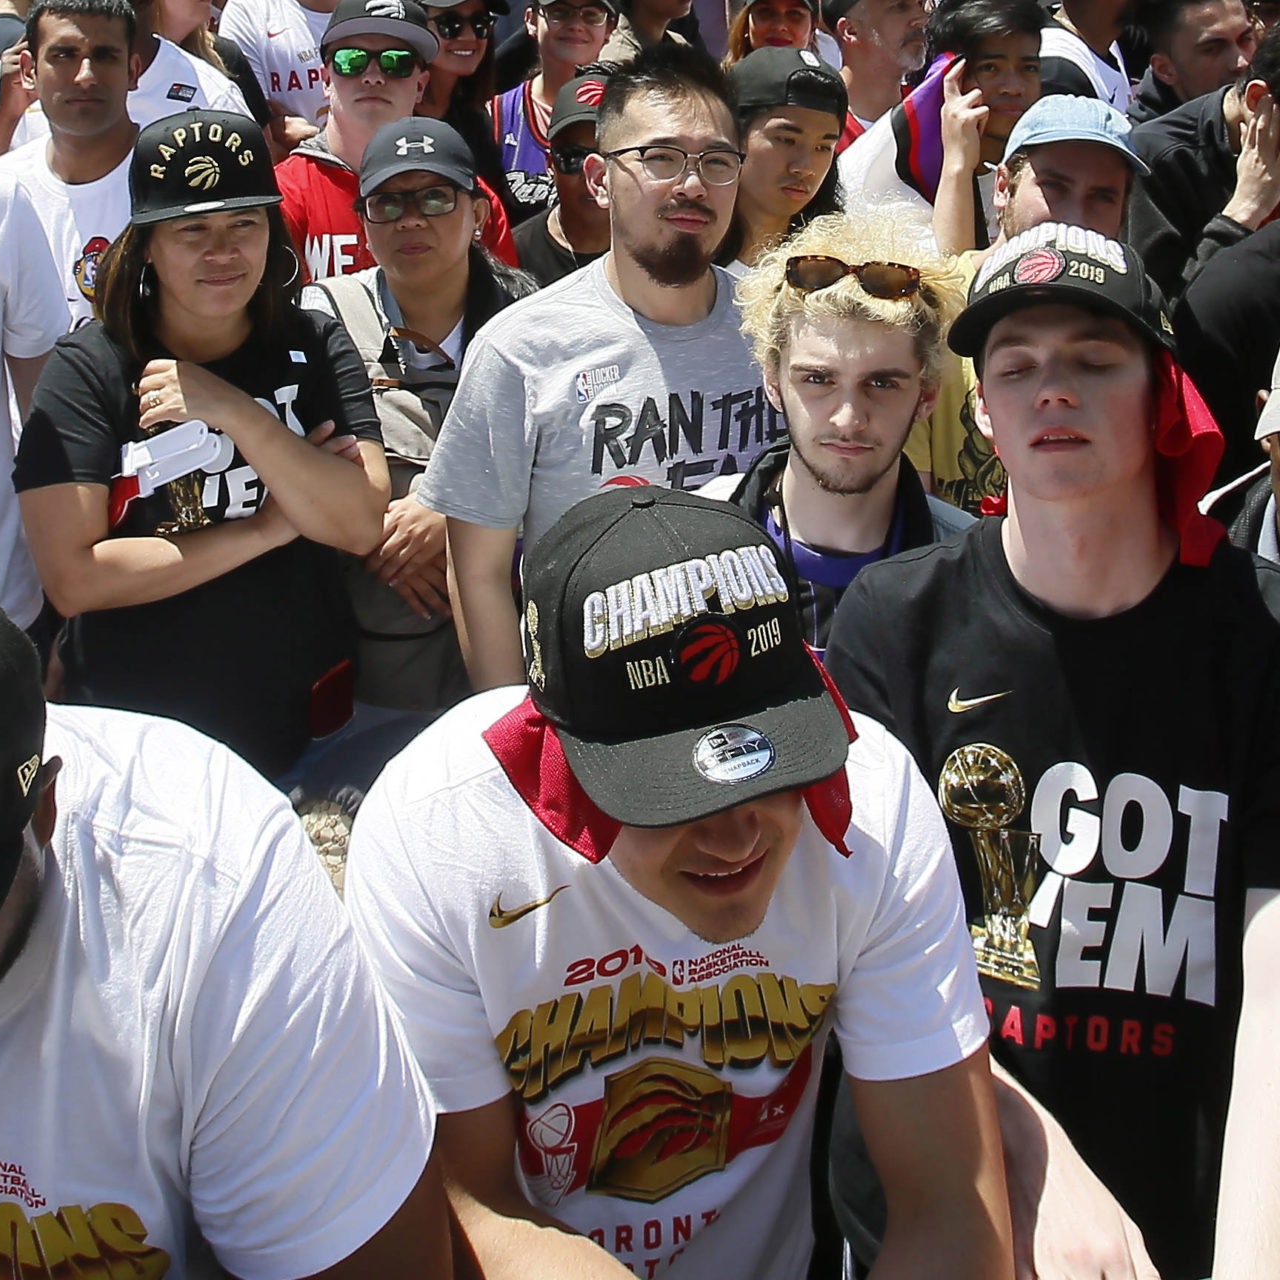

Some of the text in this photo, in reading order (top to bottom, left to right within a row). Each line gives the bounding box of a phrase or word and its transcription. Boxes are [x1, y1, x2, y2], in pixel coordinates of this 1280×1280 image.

[271, 68, 330, 92] RAP
[150, 122, 254, 180] RAPTORS
[1068, 259, 1106, 285] 2019
[593, 365, 621, 384] LOCKER
[590, 389, 706, 476] RAN
[583, 543, 789, 659] CHAMPIONS
[626, 616, 782, 692] NBA 2019
[1030, 762, 1229, 896] GOT
[687, 951, 769, 978] BASKETBALL
[688, 942, 744, 968] NATIONAL
[1026, 872, 1217, 1007] 'EM
[687, 959, 769, 985] ASSOCIATION
[495, 971, 838, 1102] CHAMPIONS
[984, 1000, 1176, 1055] APTORS
